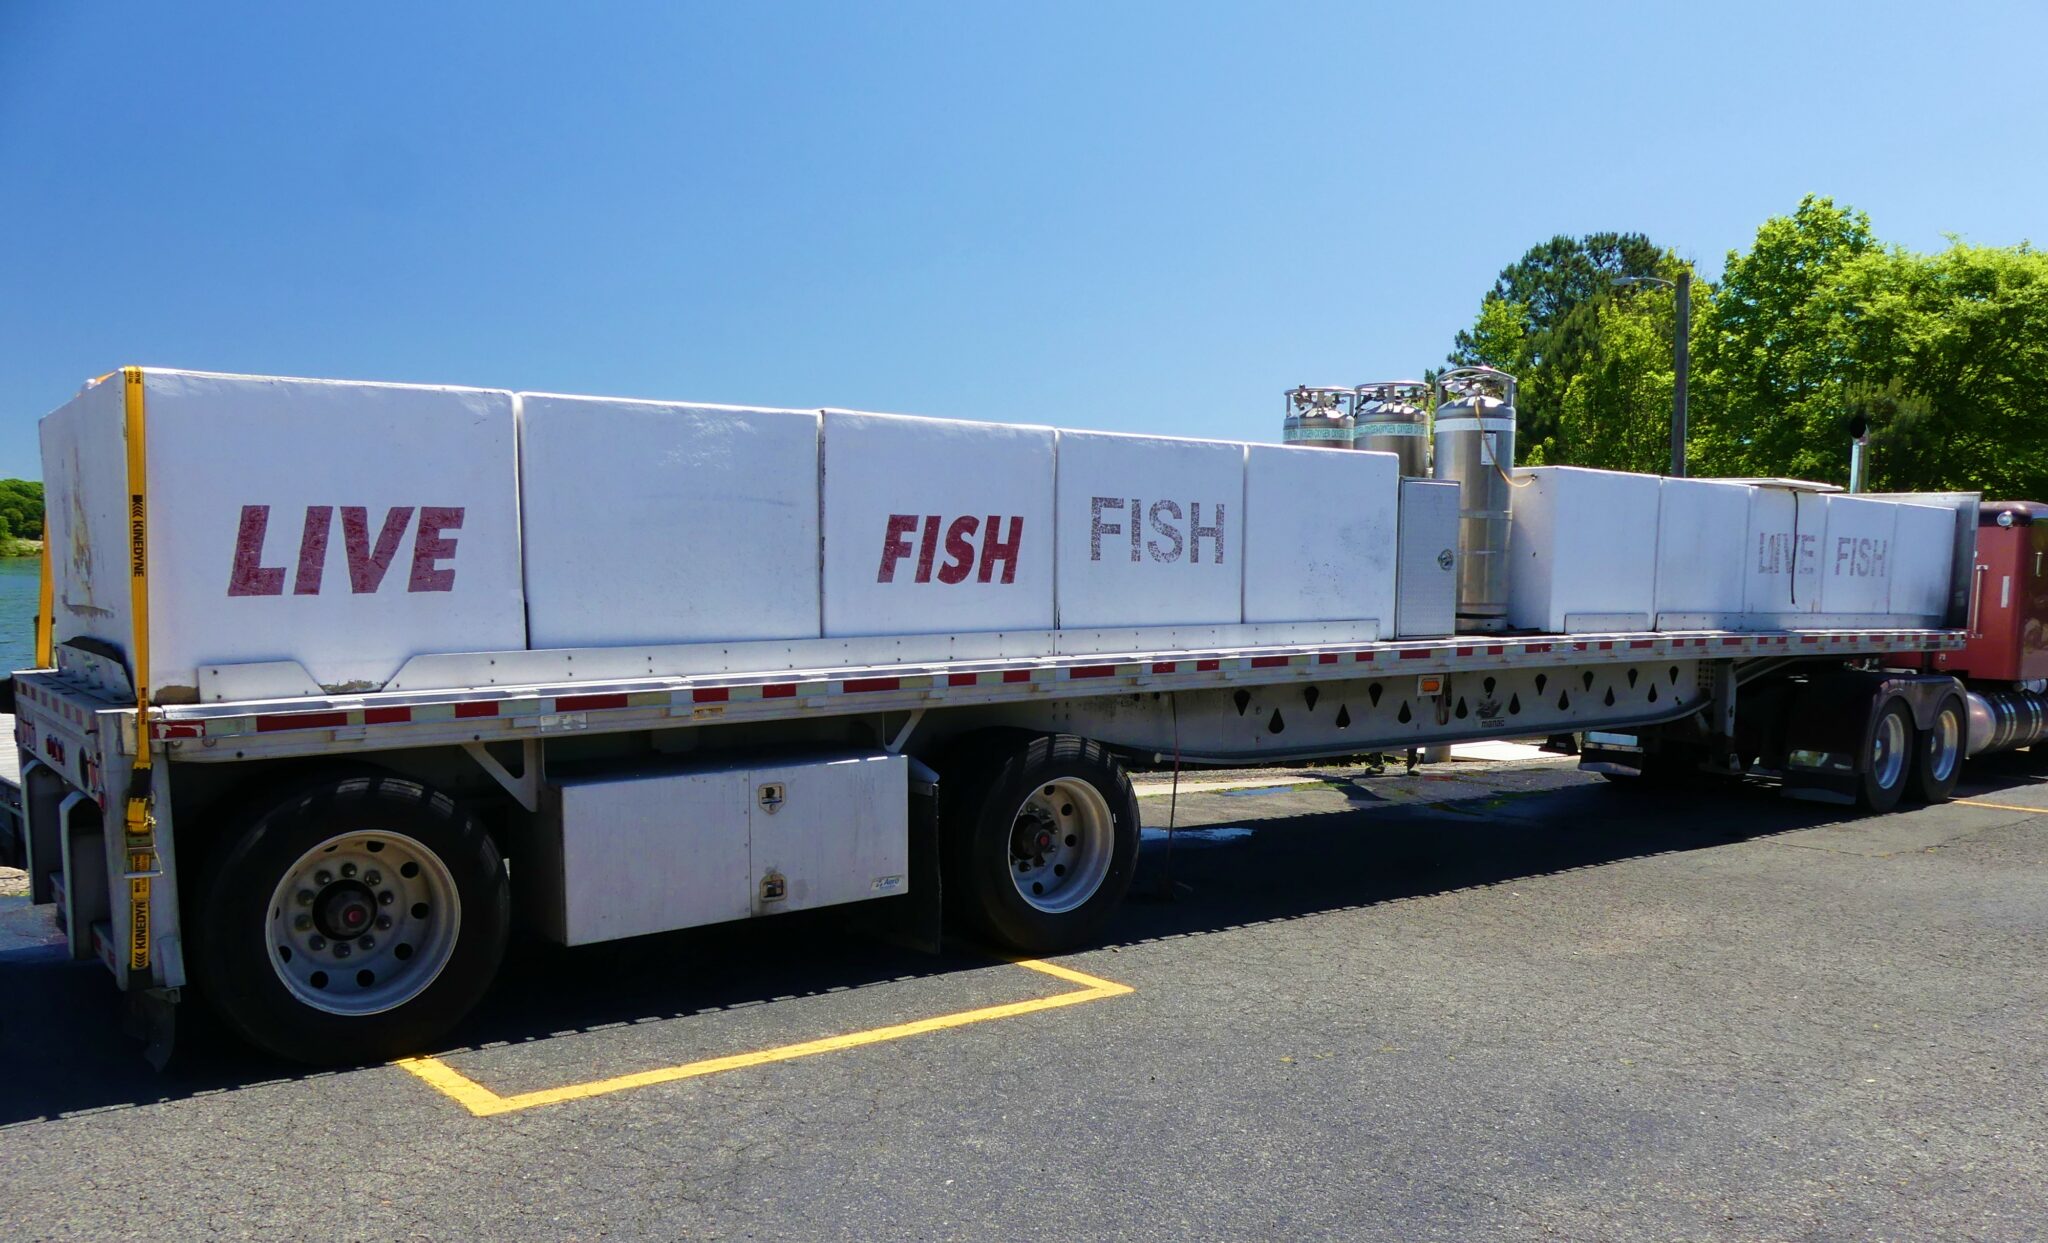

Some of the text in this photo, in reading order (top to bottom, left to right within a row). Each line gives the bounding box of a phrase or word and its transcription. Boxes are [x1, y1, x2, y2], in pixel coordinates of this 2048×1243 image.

[132, 520, 144, 577] KINEDYNE
[228, 505, 465, 596] LIVE
[877, 514, 1024, 584] FISH
[1091, 496, 1225, 564] FISH
[1834, 536, 1888, 577] FISH
[135, 900, 147, 950] KINEDYN
